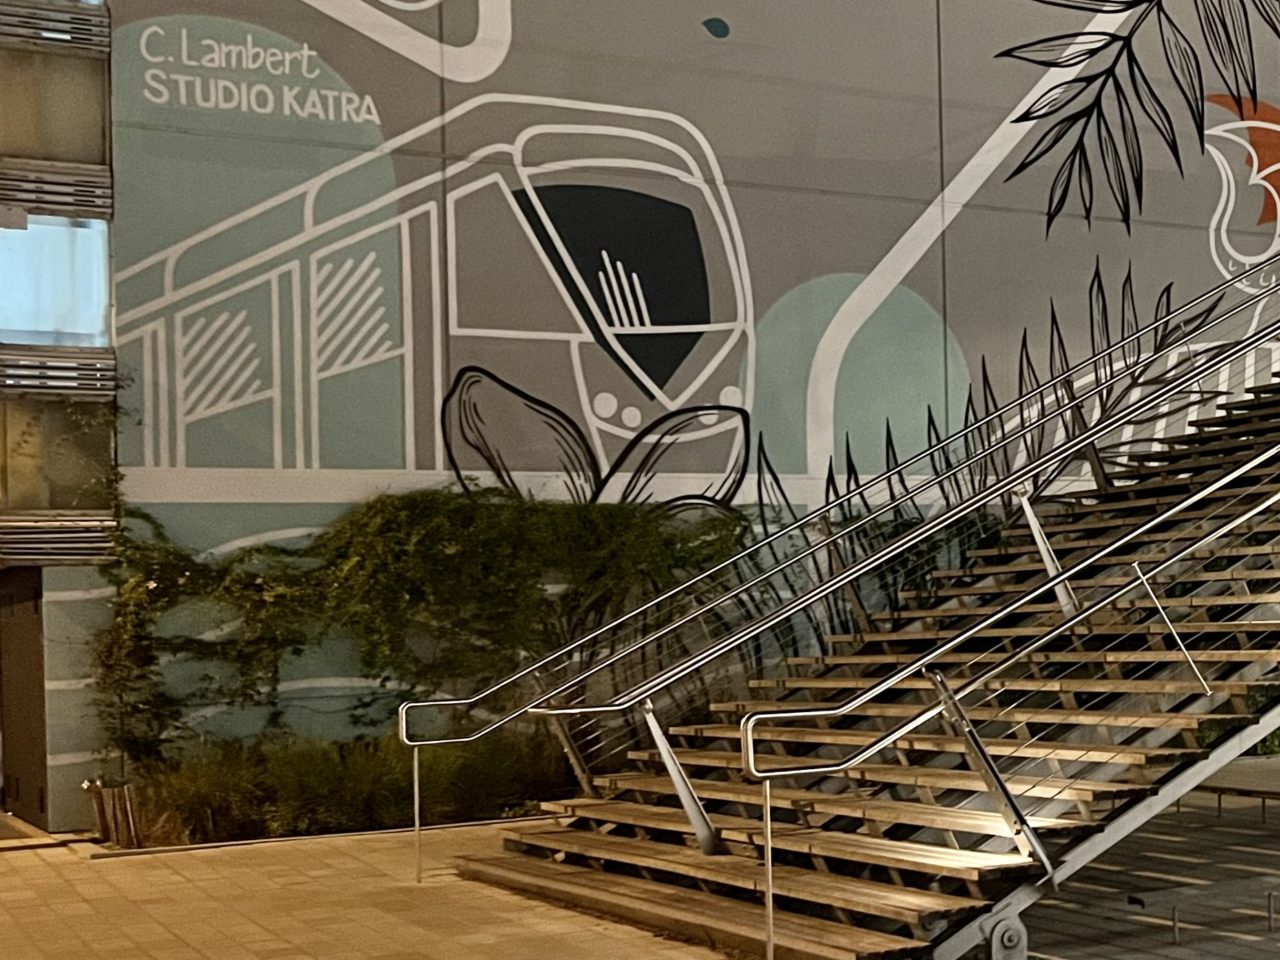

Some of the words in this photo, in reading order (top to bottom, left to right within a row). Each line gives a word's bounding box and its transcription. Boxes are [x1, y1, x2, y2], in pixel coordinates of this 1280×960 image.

[140, 25, 174, 63] C.
[181, 27, 320, 78] Lambert
[143, 69, 274, 114] STUDIO
[283, 85, 381, 125] KATRA
